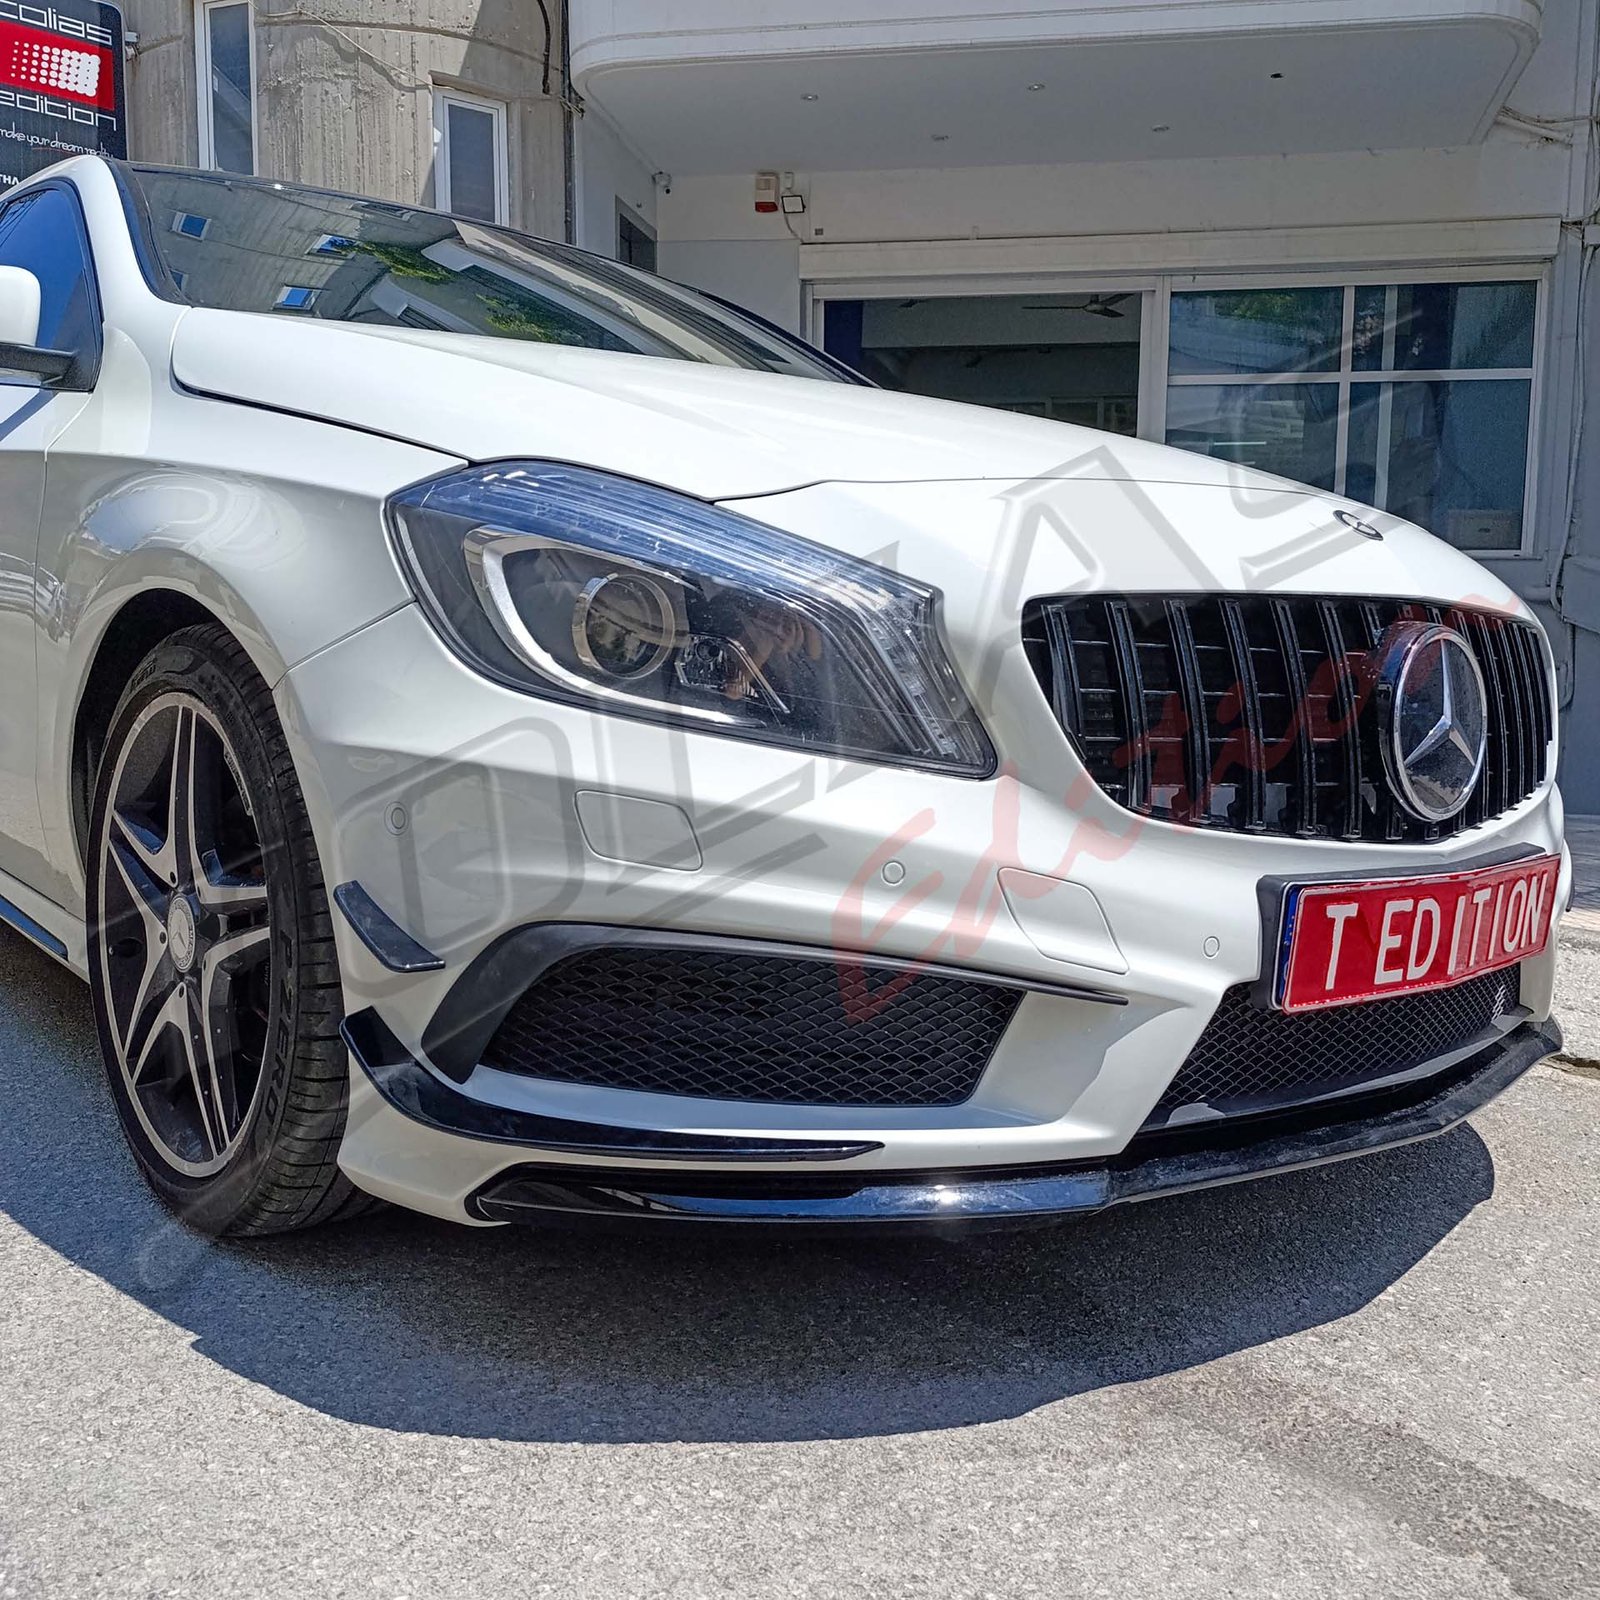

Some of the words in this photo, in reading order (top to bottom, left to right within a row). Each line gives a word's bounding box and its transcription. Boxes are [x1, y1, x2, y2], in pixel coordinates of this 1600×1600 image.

[27, 135, 50, 146] your
[50, 131, 83, 154] dream
[1326, 902, 1358, 991] T
[1374, 870, 1549, 985] EDITION
[265, 978, 293, 1126] ZERO
